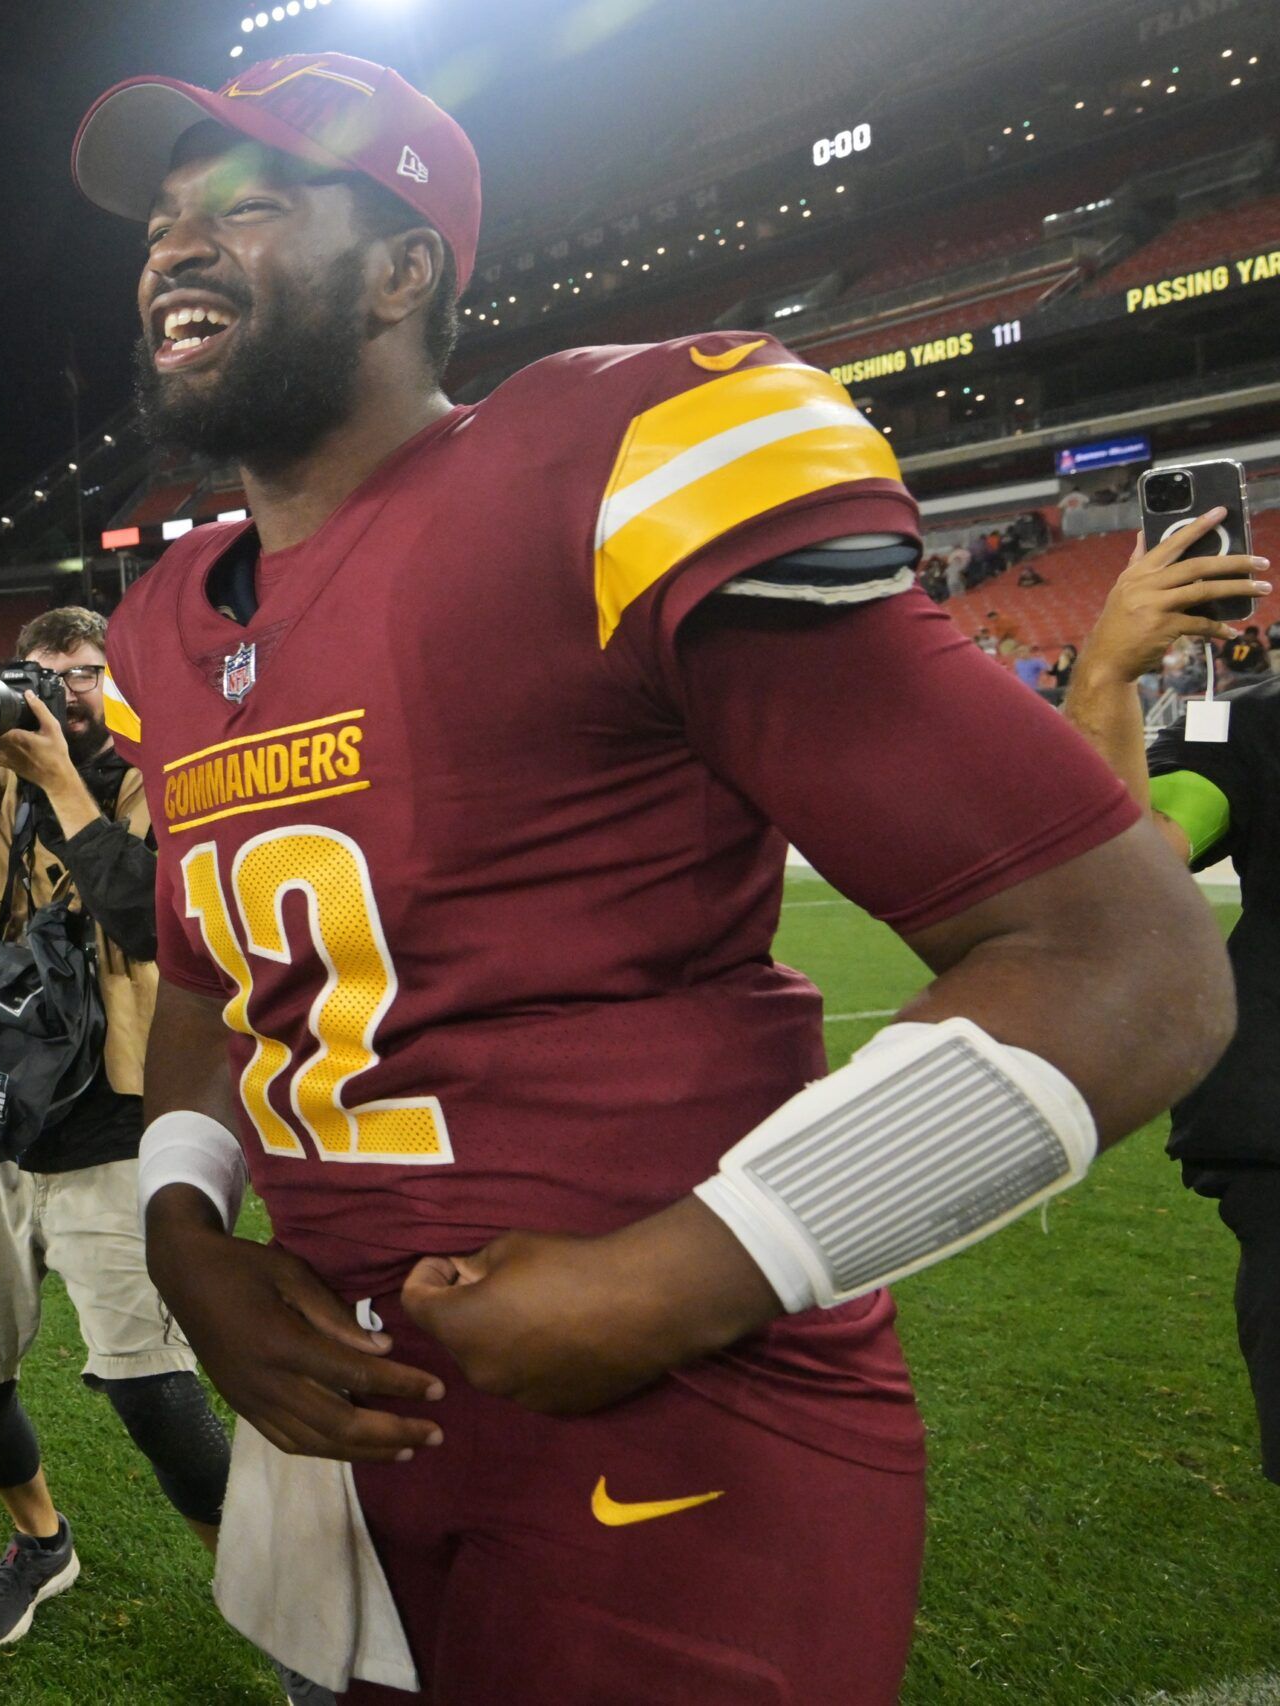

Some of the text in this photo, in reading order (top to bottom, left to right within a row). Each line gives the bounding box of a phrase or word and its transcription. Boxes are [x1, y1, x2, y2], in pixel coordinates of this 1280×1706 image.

[812, 123, 872, 167] 0:00
[1126, 265, 1229, 314] PASSING
[910, 333, 974, 367] YARDS
[992, 320, 1021, 347] 111
[228, 668, 249, 692] NFL
[164, 726, 364, 820] COMMANDERS
[180, 825, 454, 1164] 12
